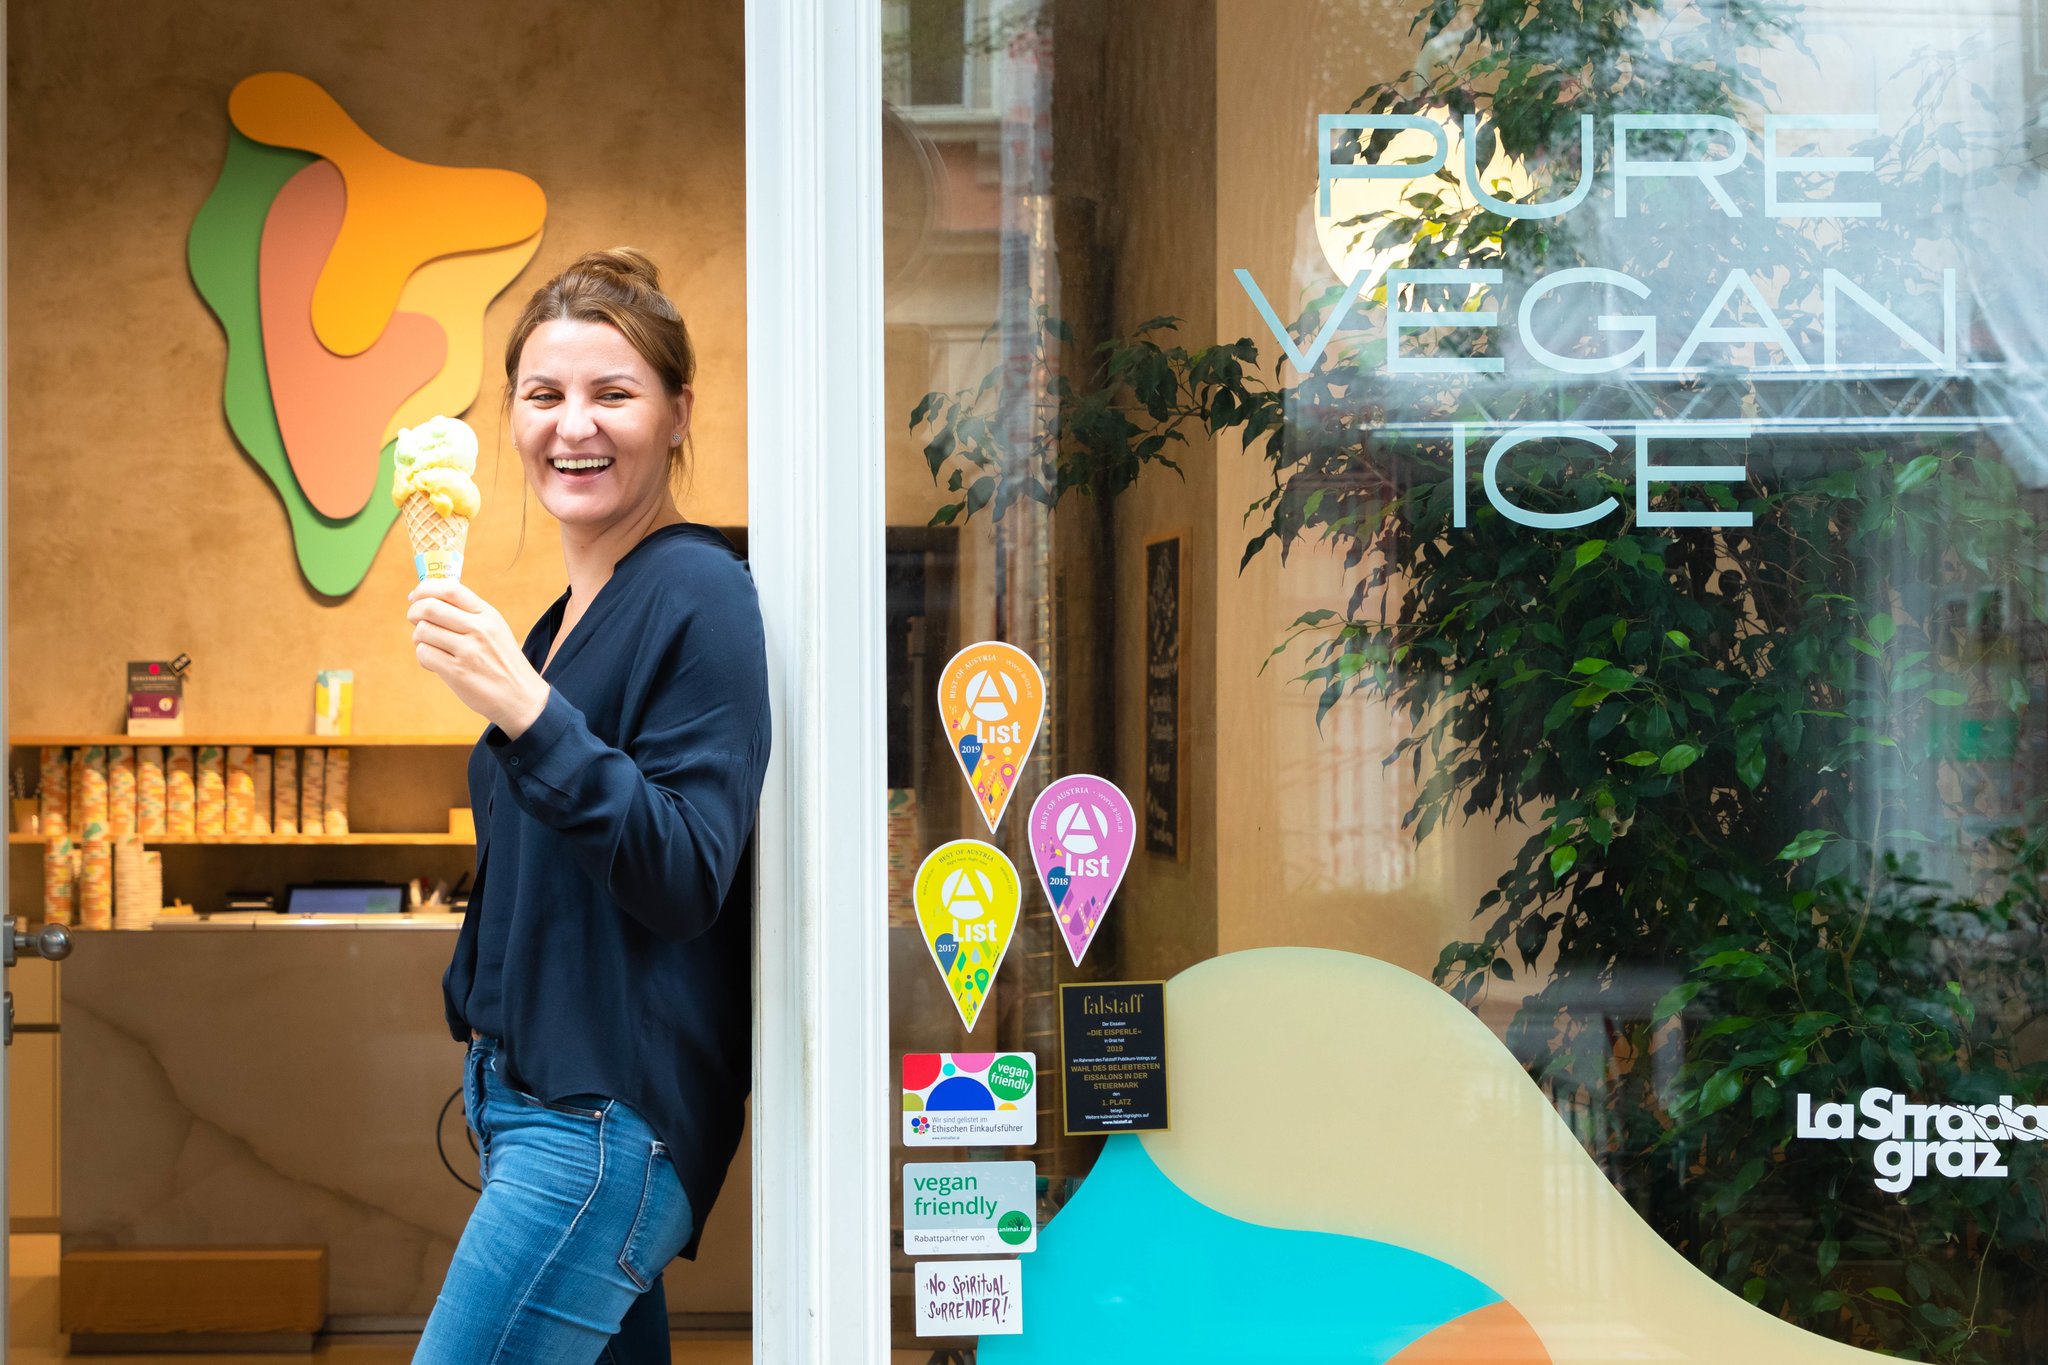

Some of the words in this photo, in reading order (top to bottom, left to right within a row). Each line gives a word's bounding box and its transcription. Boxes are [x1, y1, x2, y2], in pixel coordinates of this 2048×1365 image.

[1318, 114, 1881, 219] PURE
[1233, 267, 1956, 374] VEGAN
[1452, 422, 1754, 529] ICE
[950, 681, 958, 699] BEST
[956, 669, 964, 679] OF
[965, 654, 997, 670] AUSTRIA
[961, 745, 981, 754] 2019
[1040, 809, 1050, 830] BEST
[1047, 799, 1057, 810] OF
[1056, 787, 1089, 802] AUSTRIA
[939, 852, 953, 864] BEST
[966, 849, 994, 862] AUSTRIA
[1049, 877, 1069, 886] 2018
[937, 944, 957, 953] 2017
[1083, 993, 1144, 1015] falstaff
[997, 1063, 1029, 1079] vegan
[1108, 1063, 1160, 1071] BELIEBTESTEN
[991, 1072, 1031, 1093] friendly
[1084, 1073, 1123, 1081] EISSALONS
[1093, 1082, 1139, 1090] STEIERMARK
[957, 1116, 979, 1124] gelistet
[932, 1125, 968, 1133] Ethischen
[970, 1124, 1023, 1132] Einkaufsführer
[1873, 1140, 2008, 1193] graz
[913, 1175, 977, 1196] vegan
[914, 1196, 998, 1219] friendly
[914, 1235, 968, 1243] Rabattpartner
